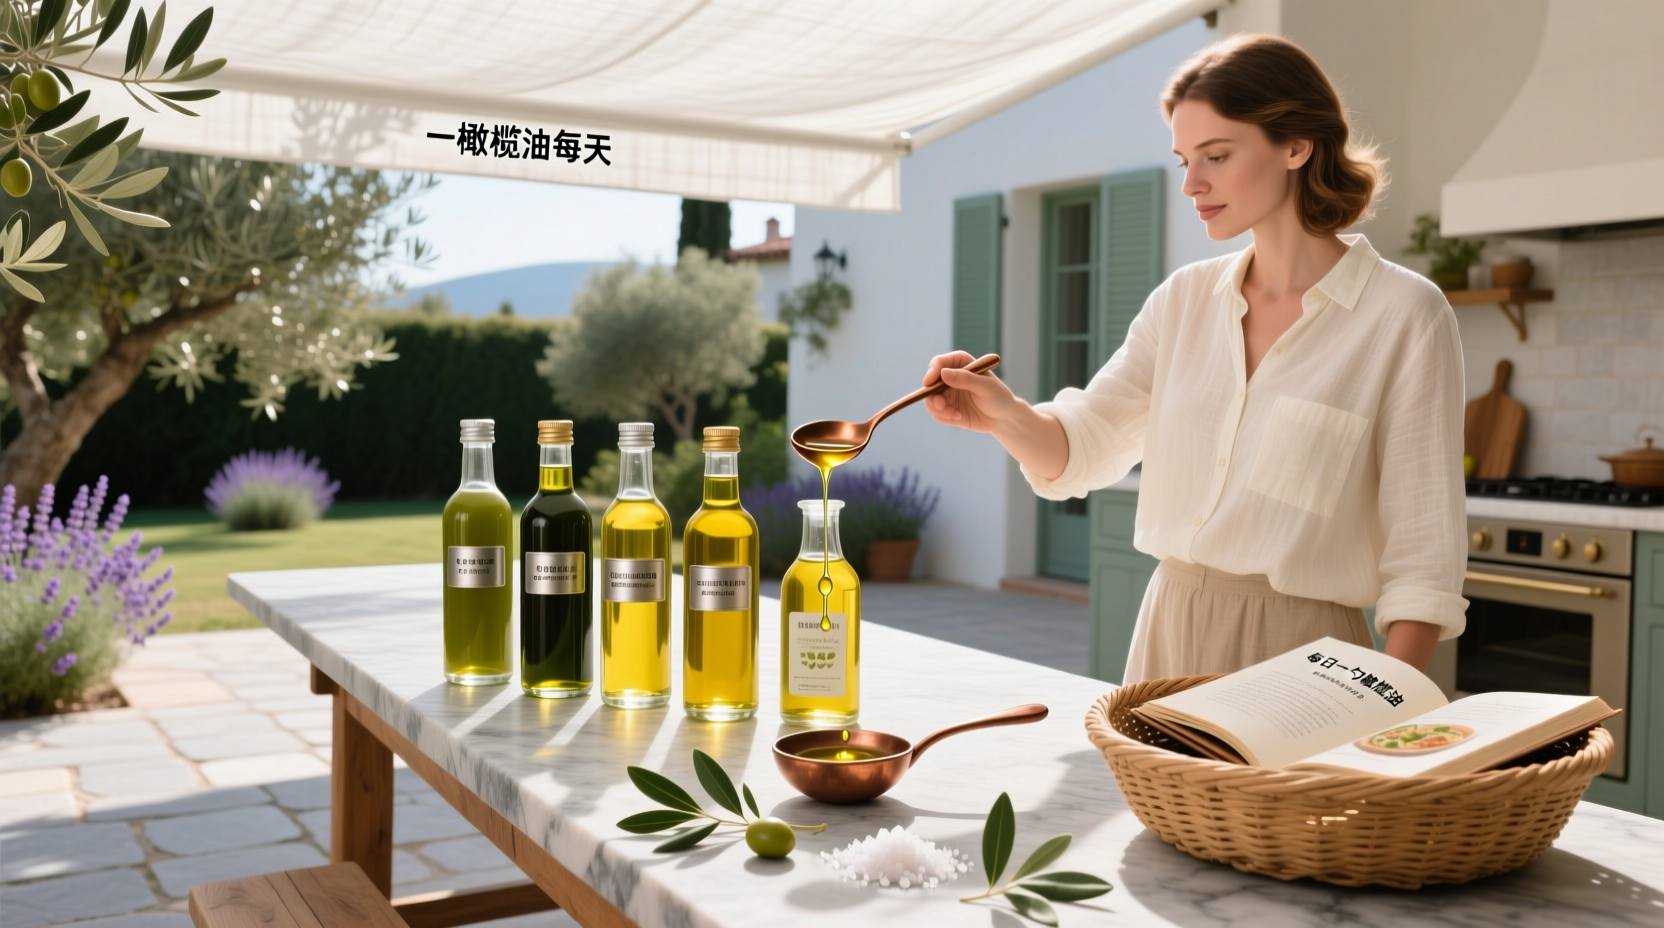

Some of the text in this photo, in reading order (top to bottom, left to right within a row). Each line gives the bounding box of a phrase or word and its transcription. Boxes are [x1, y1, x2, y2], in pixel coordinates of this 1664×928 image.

[426, 121, 612, 167] 一橄榄油每天
